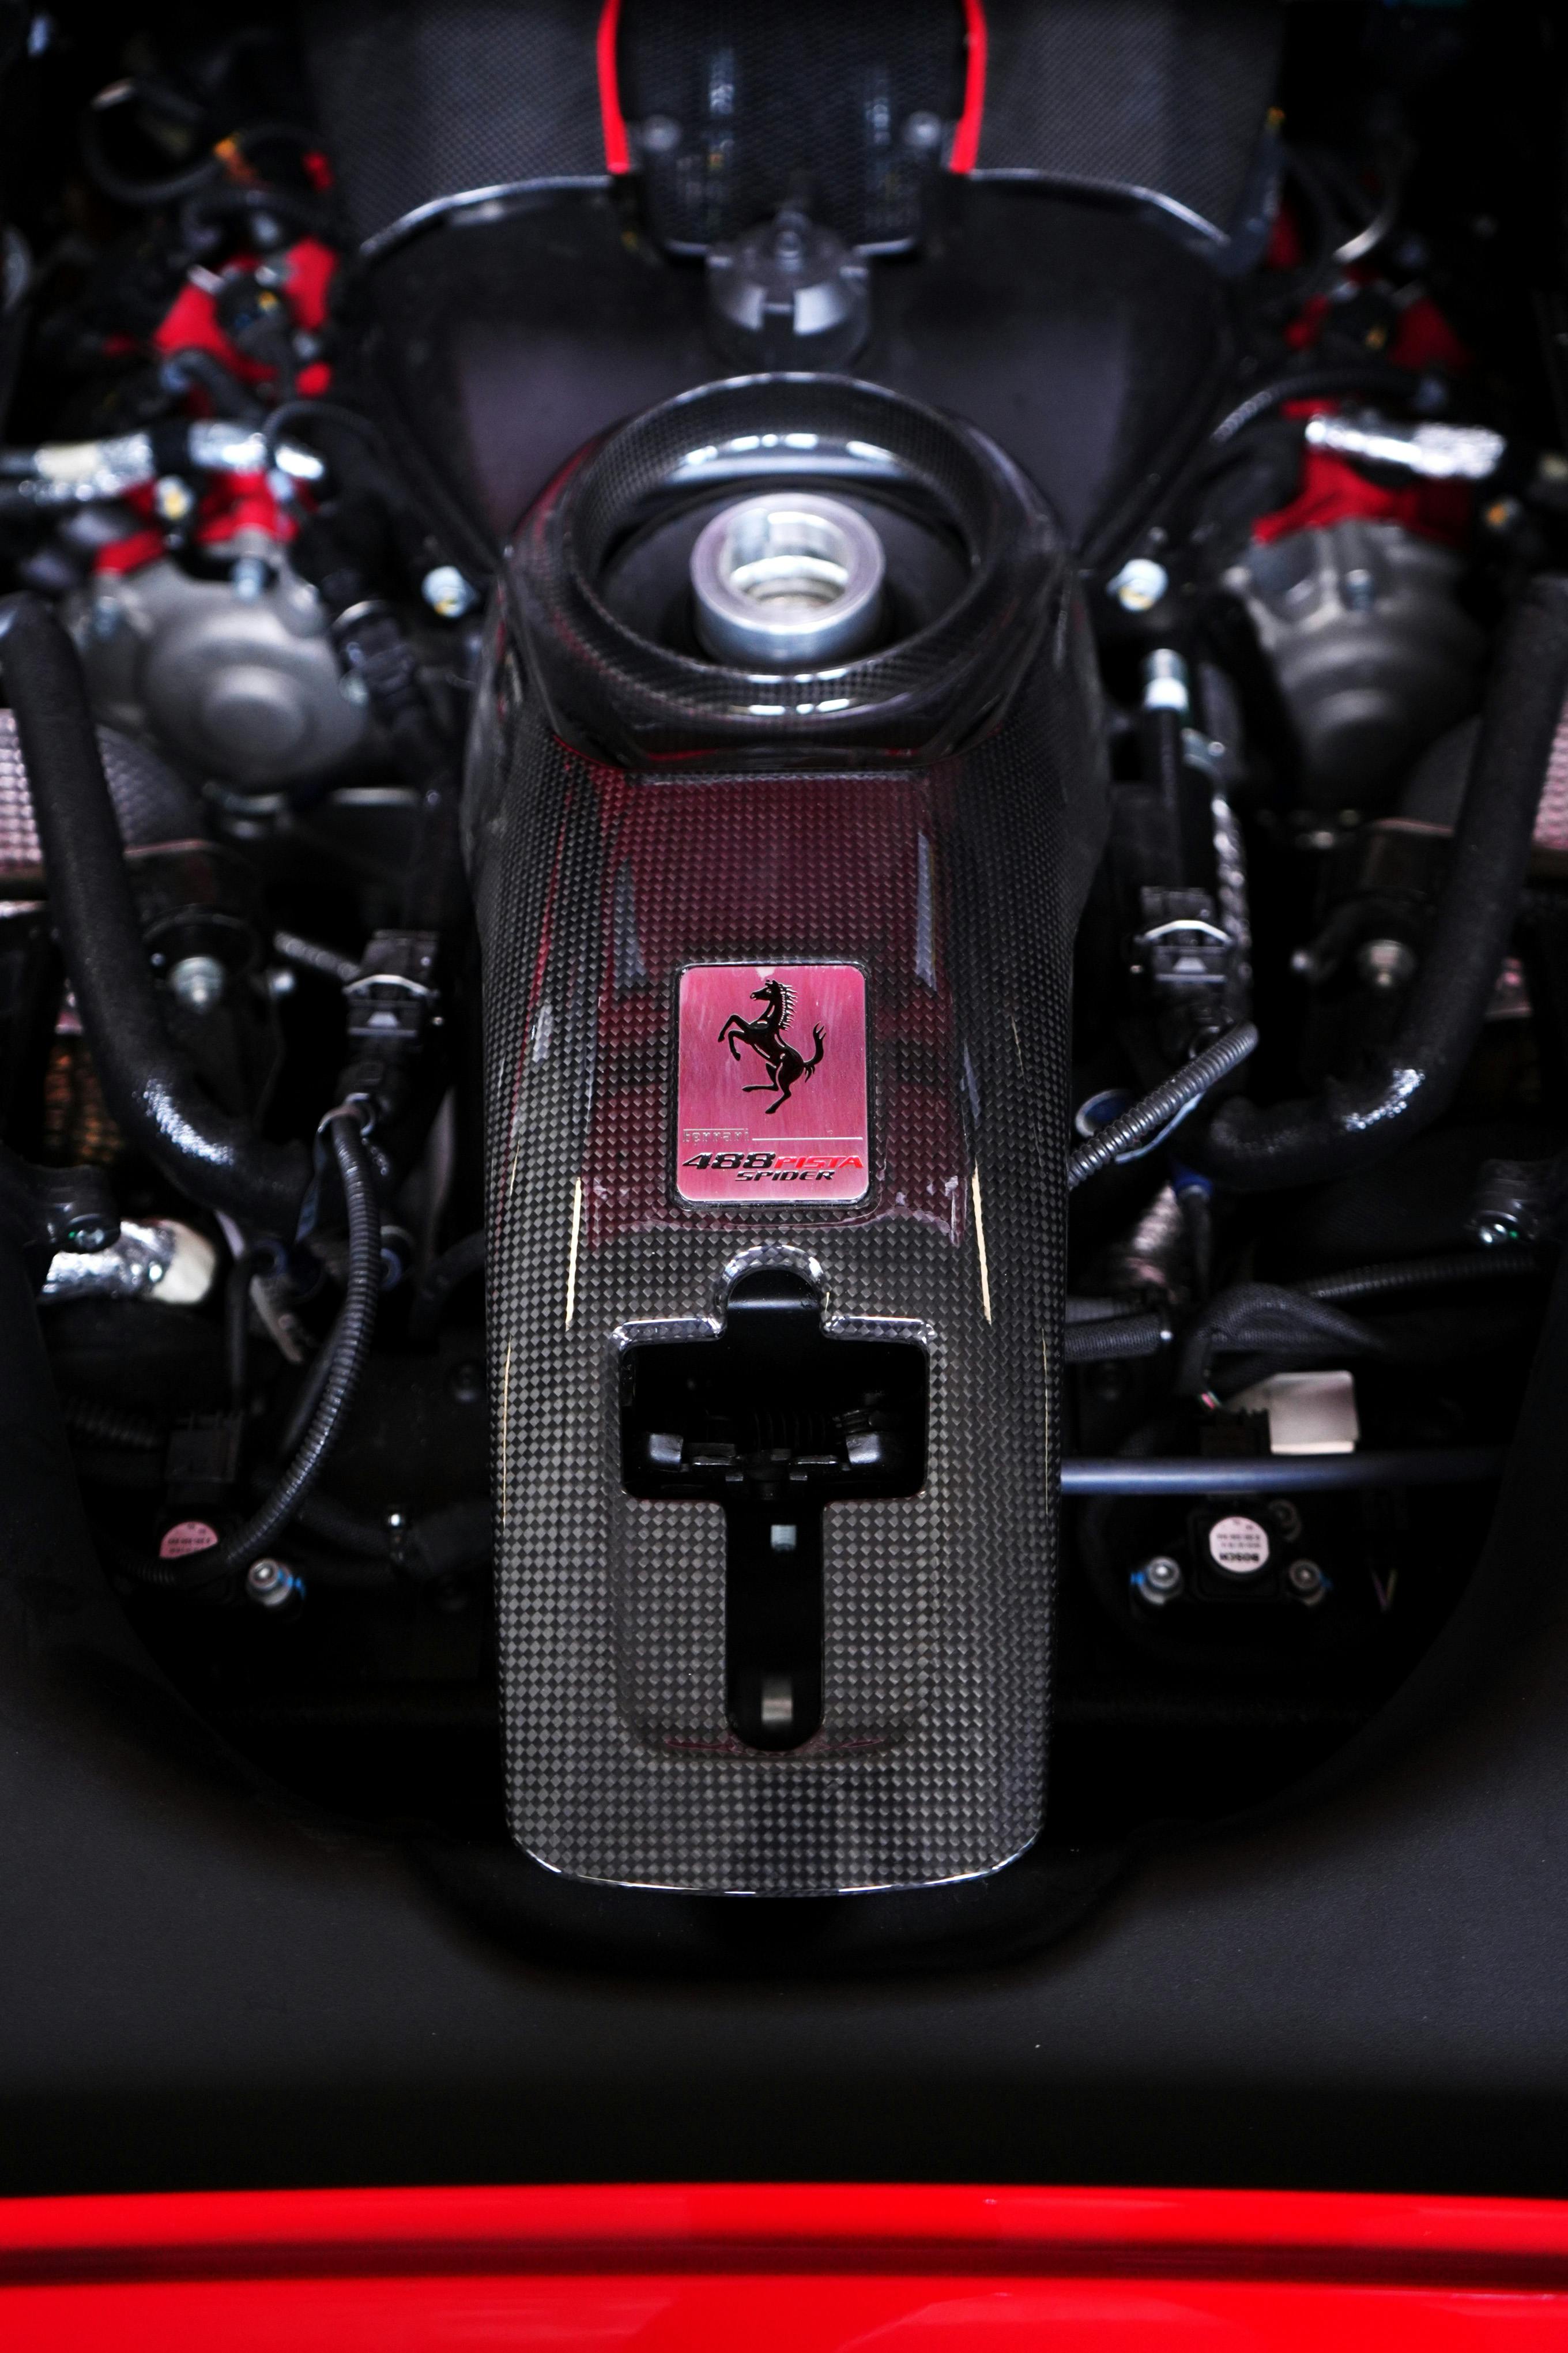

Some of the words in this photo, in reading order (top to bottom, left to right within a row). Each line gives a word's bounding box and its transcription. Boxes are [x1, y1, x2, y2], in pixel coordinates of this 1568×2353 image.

[683, 1152, 776, 1169] 488
[774, 1155, 863, 1169] PISTA
[735, 1170, 835, 1181] SPIDER
